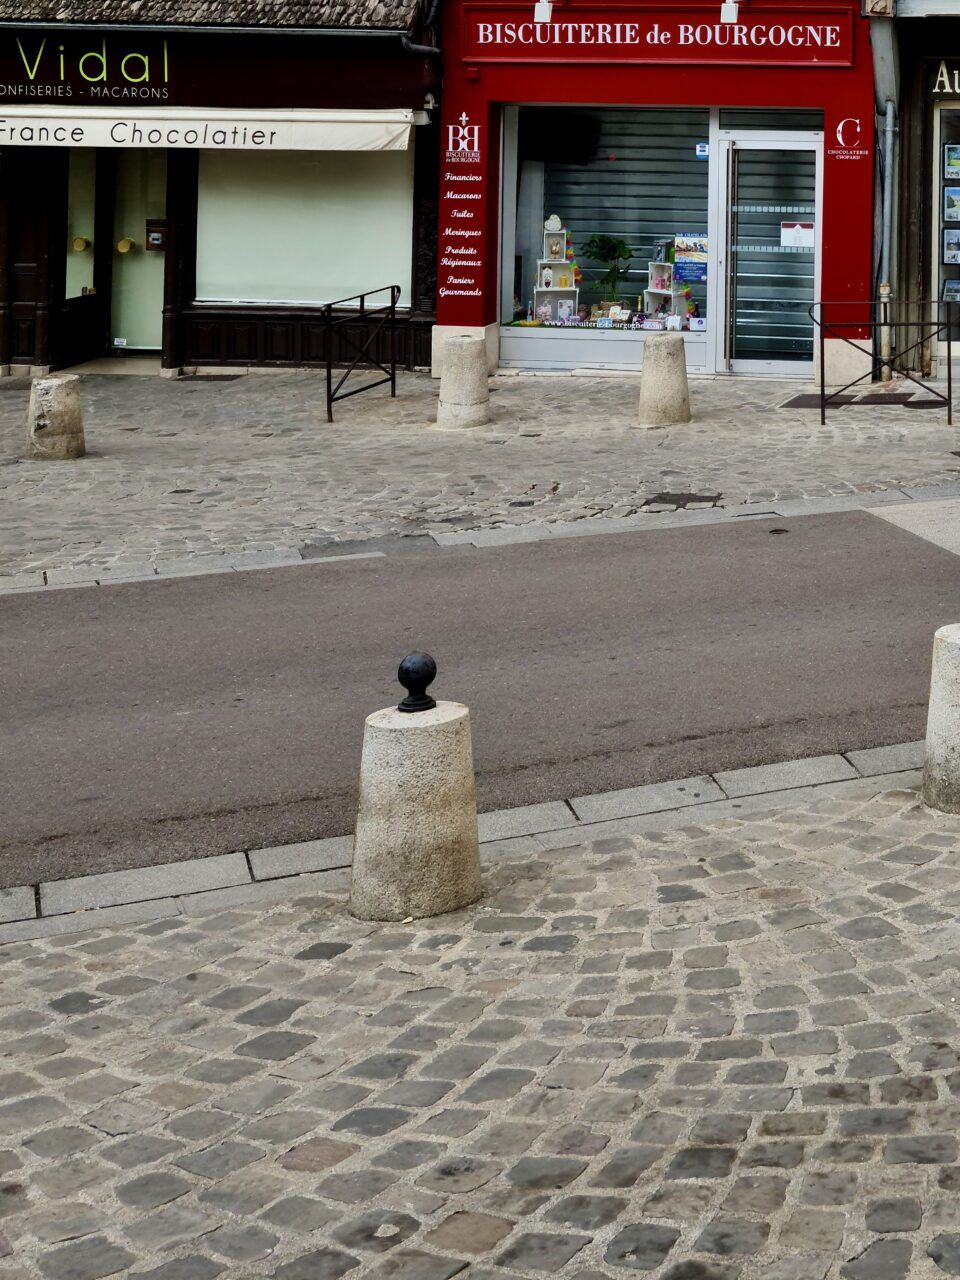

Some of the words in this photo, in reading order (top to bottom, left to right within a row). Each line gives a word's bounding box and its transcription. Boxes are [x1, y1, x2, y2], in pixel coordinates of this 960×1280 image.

[476, 23, 640, 45] BISCUITERIE
[645, 24, 671, 45] de
[677, 24, 841, 47] BOURGOGNE
[15, 37, 169, 83] Vidal
[90, 86, 169, 98] MACARONS
[110, 122, 277, 145] Chocolatier
[444, 172, 482, 181] Financiers
[444, 191, 482, 200] Macarons
[451, 209, 474, 218] Tuiles
[443, 227, 482, 238] Meringues
[444, 245, 477, 255] Produits
[440, 257, 482, 268] Régionaux
[447, 275, 475, 284] Paniers
[439, 287, 482, 297] Gourmands
